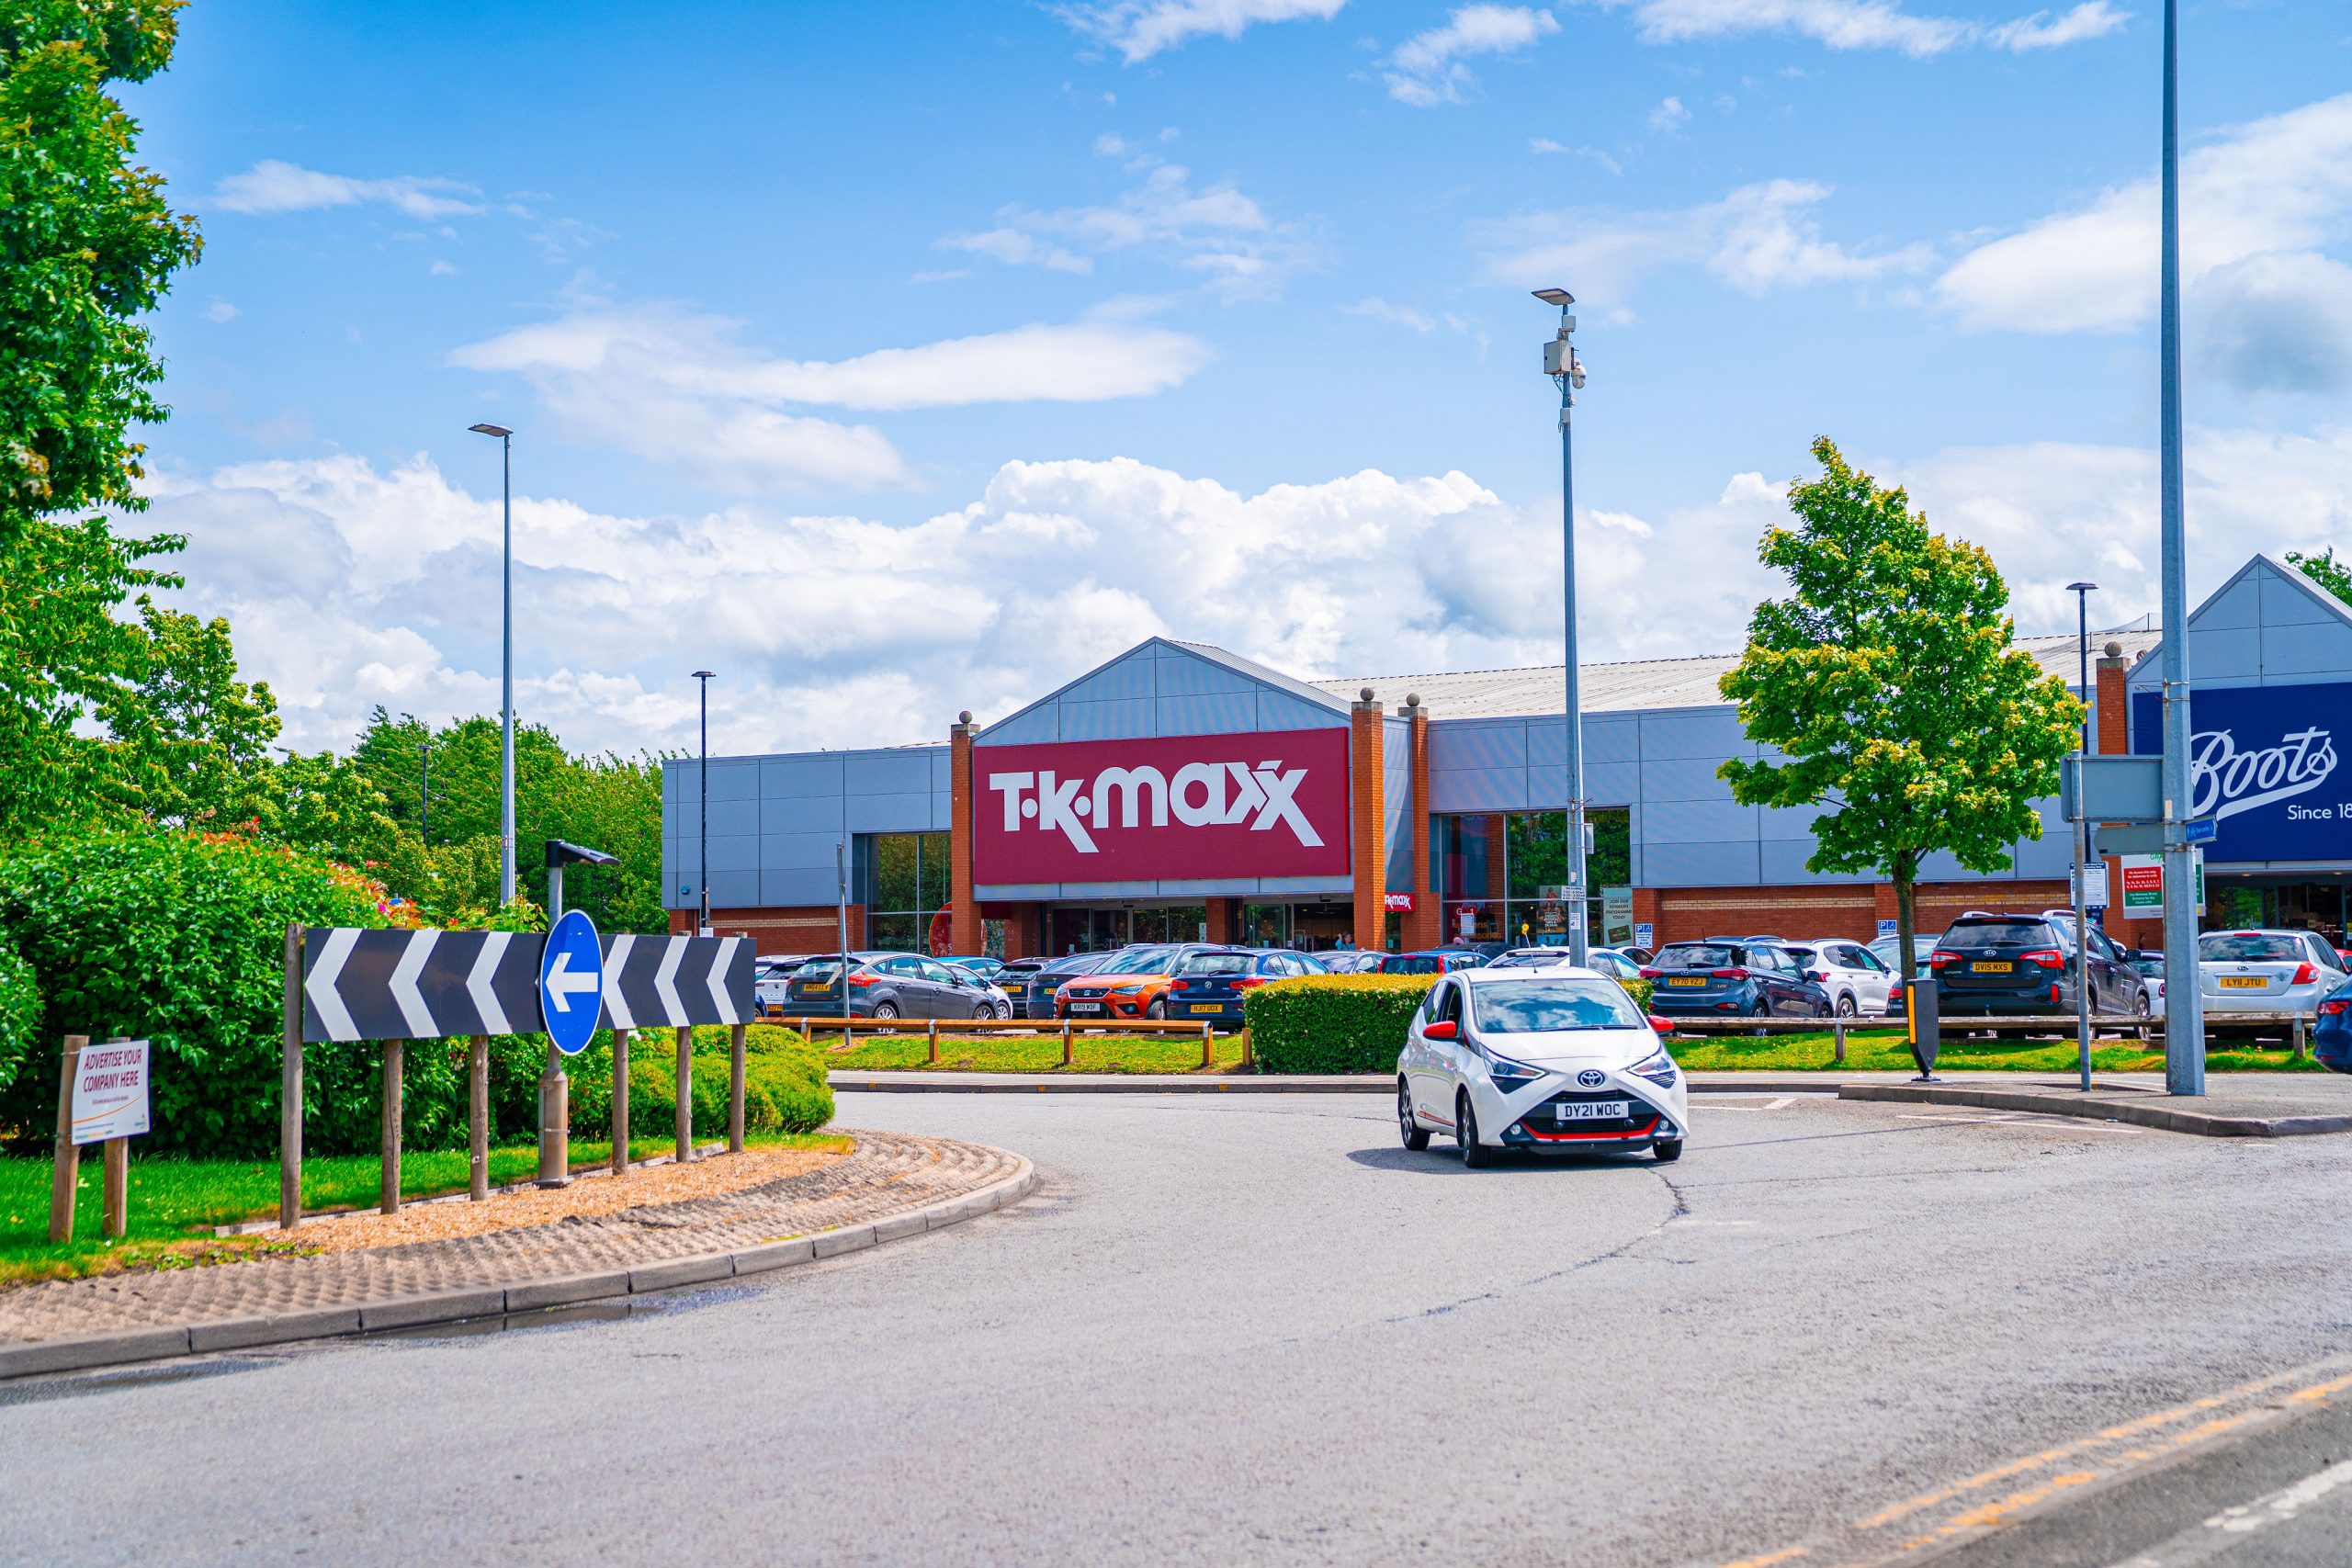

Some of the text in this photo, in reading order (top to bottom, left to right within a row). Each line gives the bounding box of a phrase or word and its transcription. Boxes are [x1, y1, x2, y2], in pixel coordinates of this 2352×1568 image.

[2191, 727, 2337, 821] Boots
[2288, 805, 2332, 819] Since
[1975, 963, 2008, 971] DV15 MXS
[1672, 977, 1689, 986] EY70
[85, 1048, 142, 1070] ADVERTISE YOUR
[83, 1070, 139, 1092] COMPANY HERE
[1565, 1103, 1621, 1118] DY21 WOC
